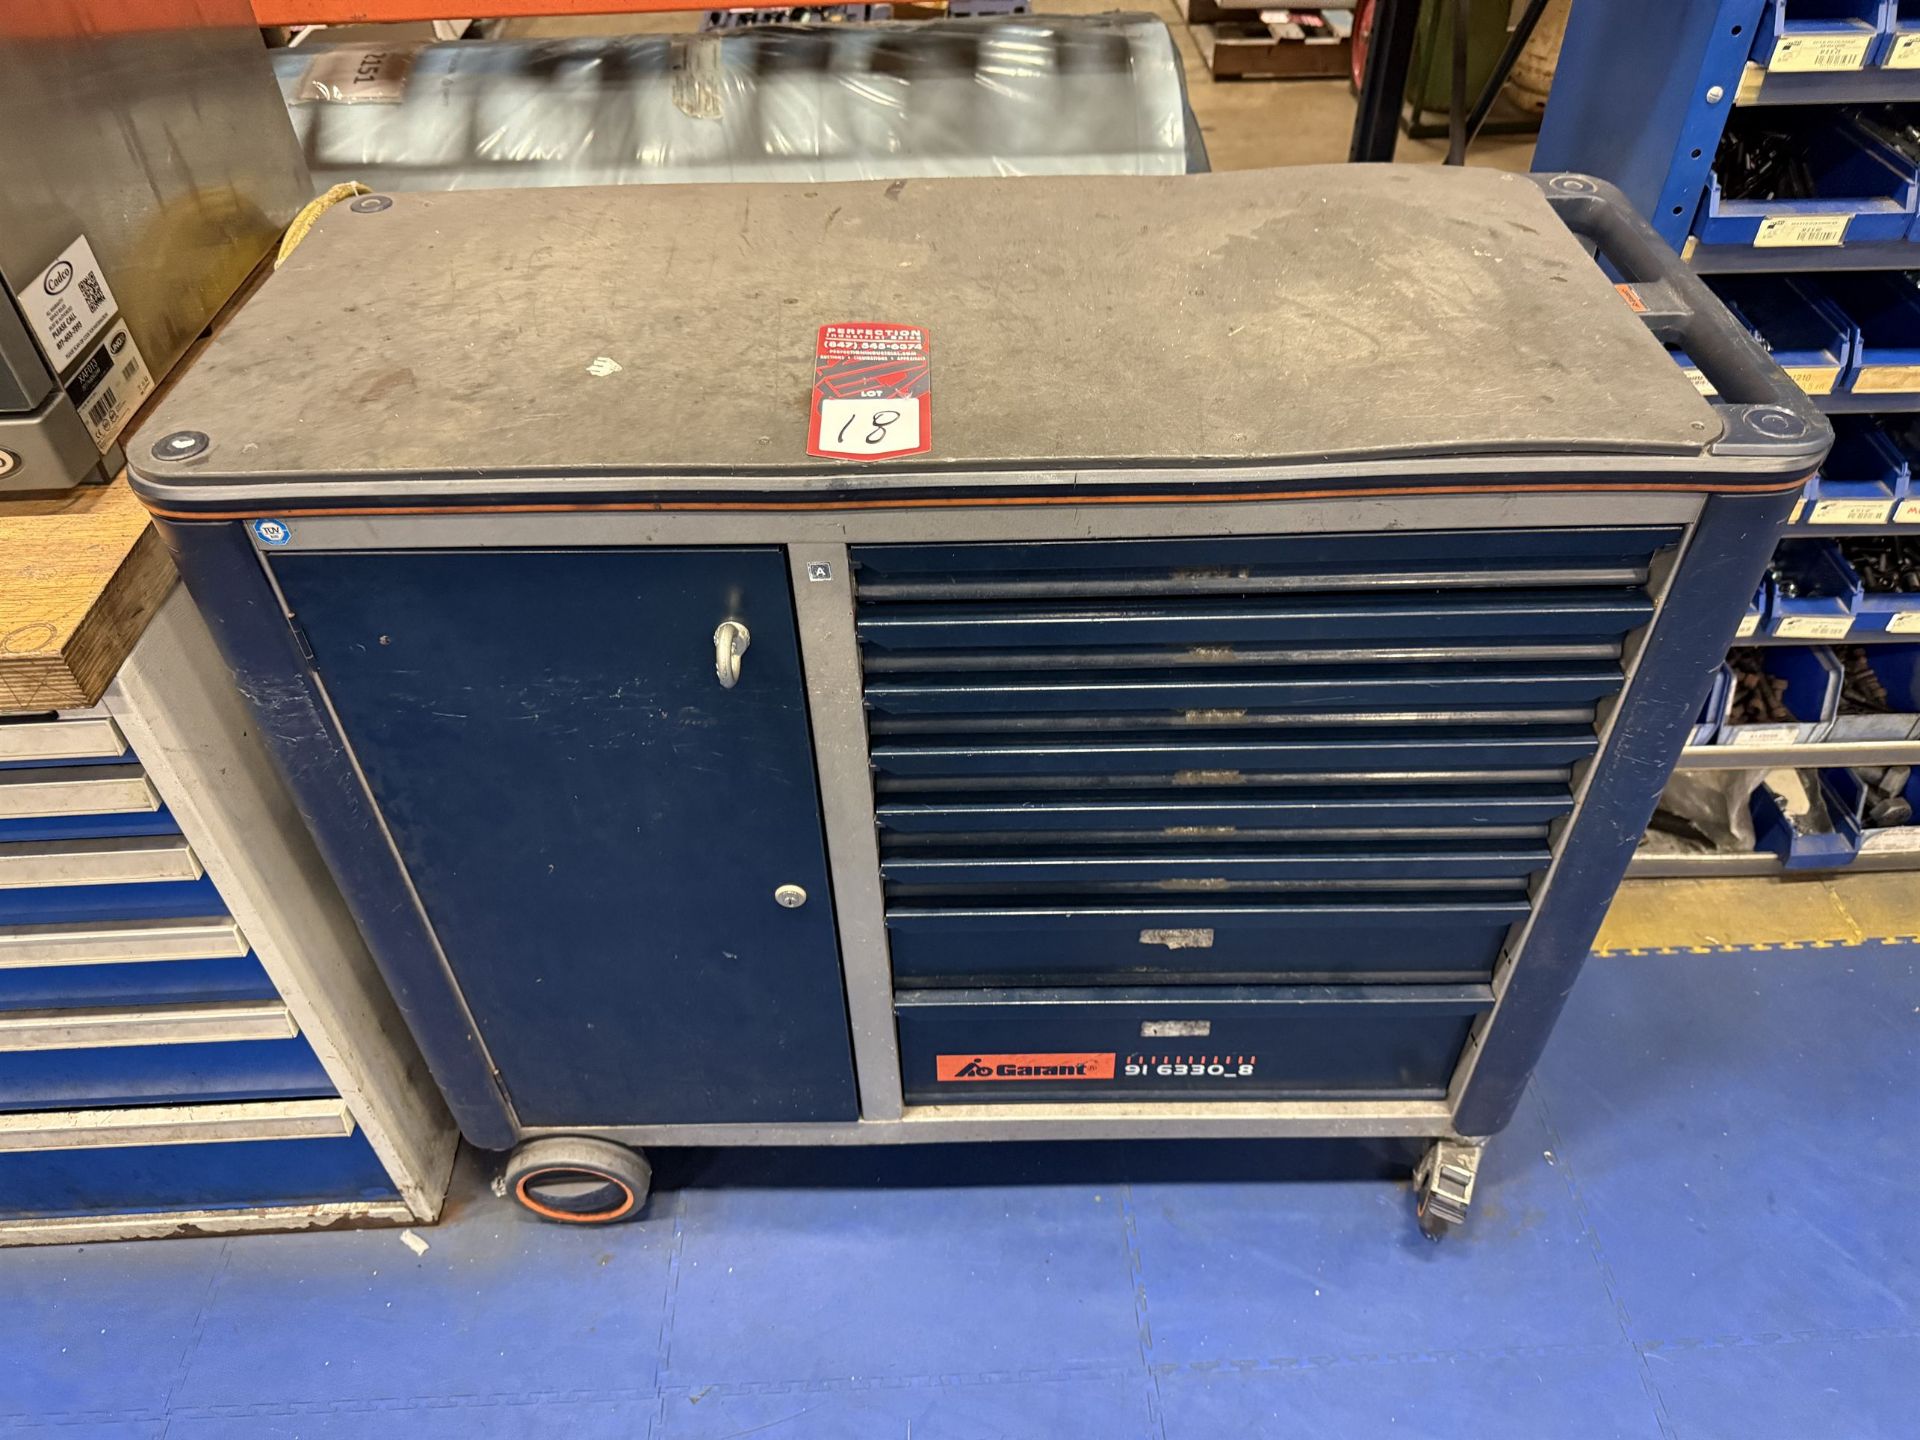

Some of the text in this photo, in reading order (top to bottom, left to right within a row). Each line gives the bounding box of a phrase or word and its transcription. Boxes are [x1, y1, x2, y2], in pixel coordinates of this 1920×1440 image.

[48, 268, 70, 290] Cadco
[52, 312, 77, 339] PLEASE CALL
[827, 327, 921, 336] PERFECTION
[824, 341, 858, 349] (847)
[837, 410, 901, 445] 18
[816, 567, 826, 576] A
[996, 1063, 1088, 1077] Garant
[1124, 1064, 1254, 1078] 91 6330_8
